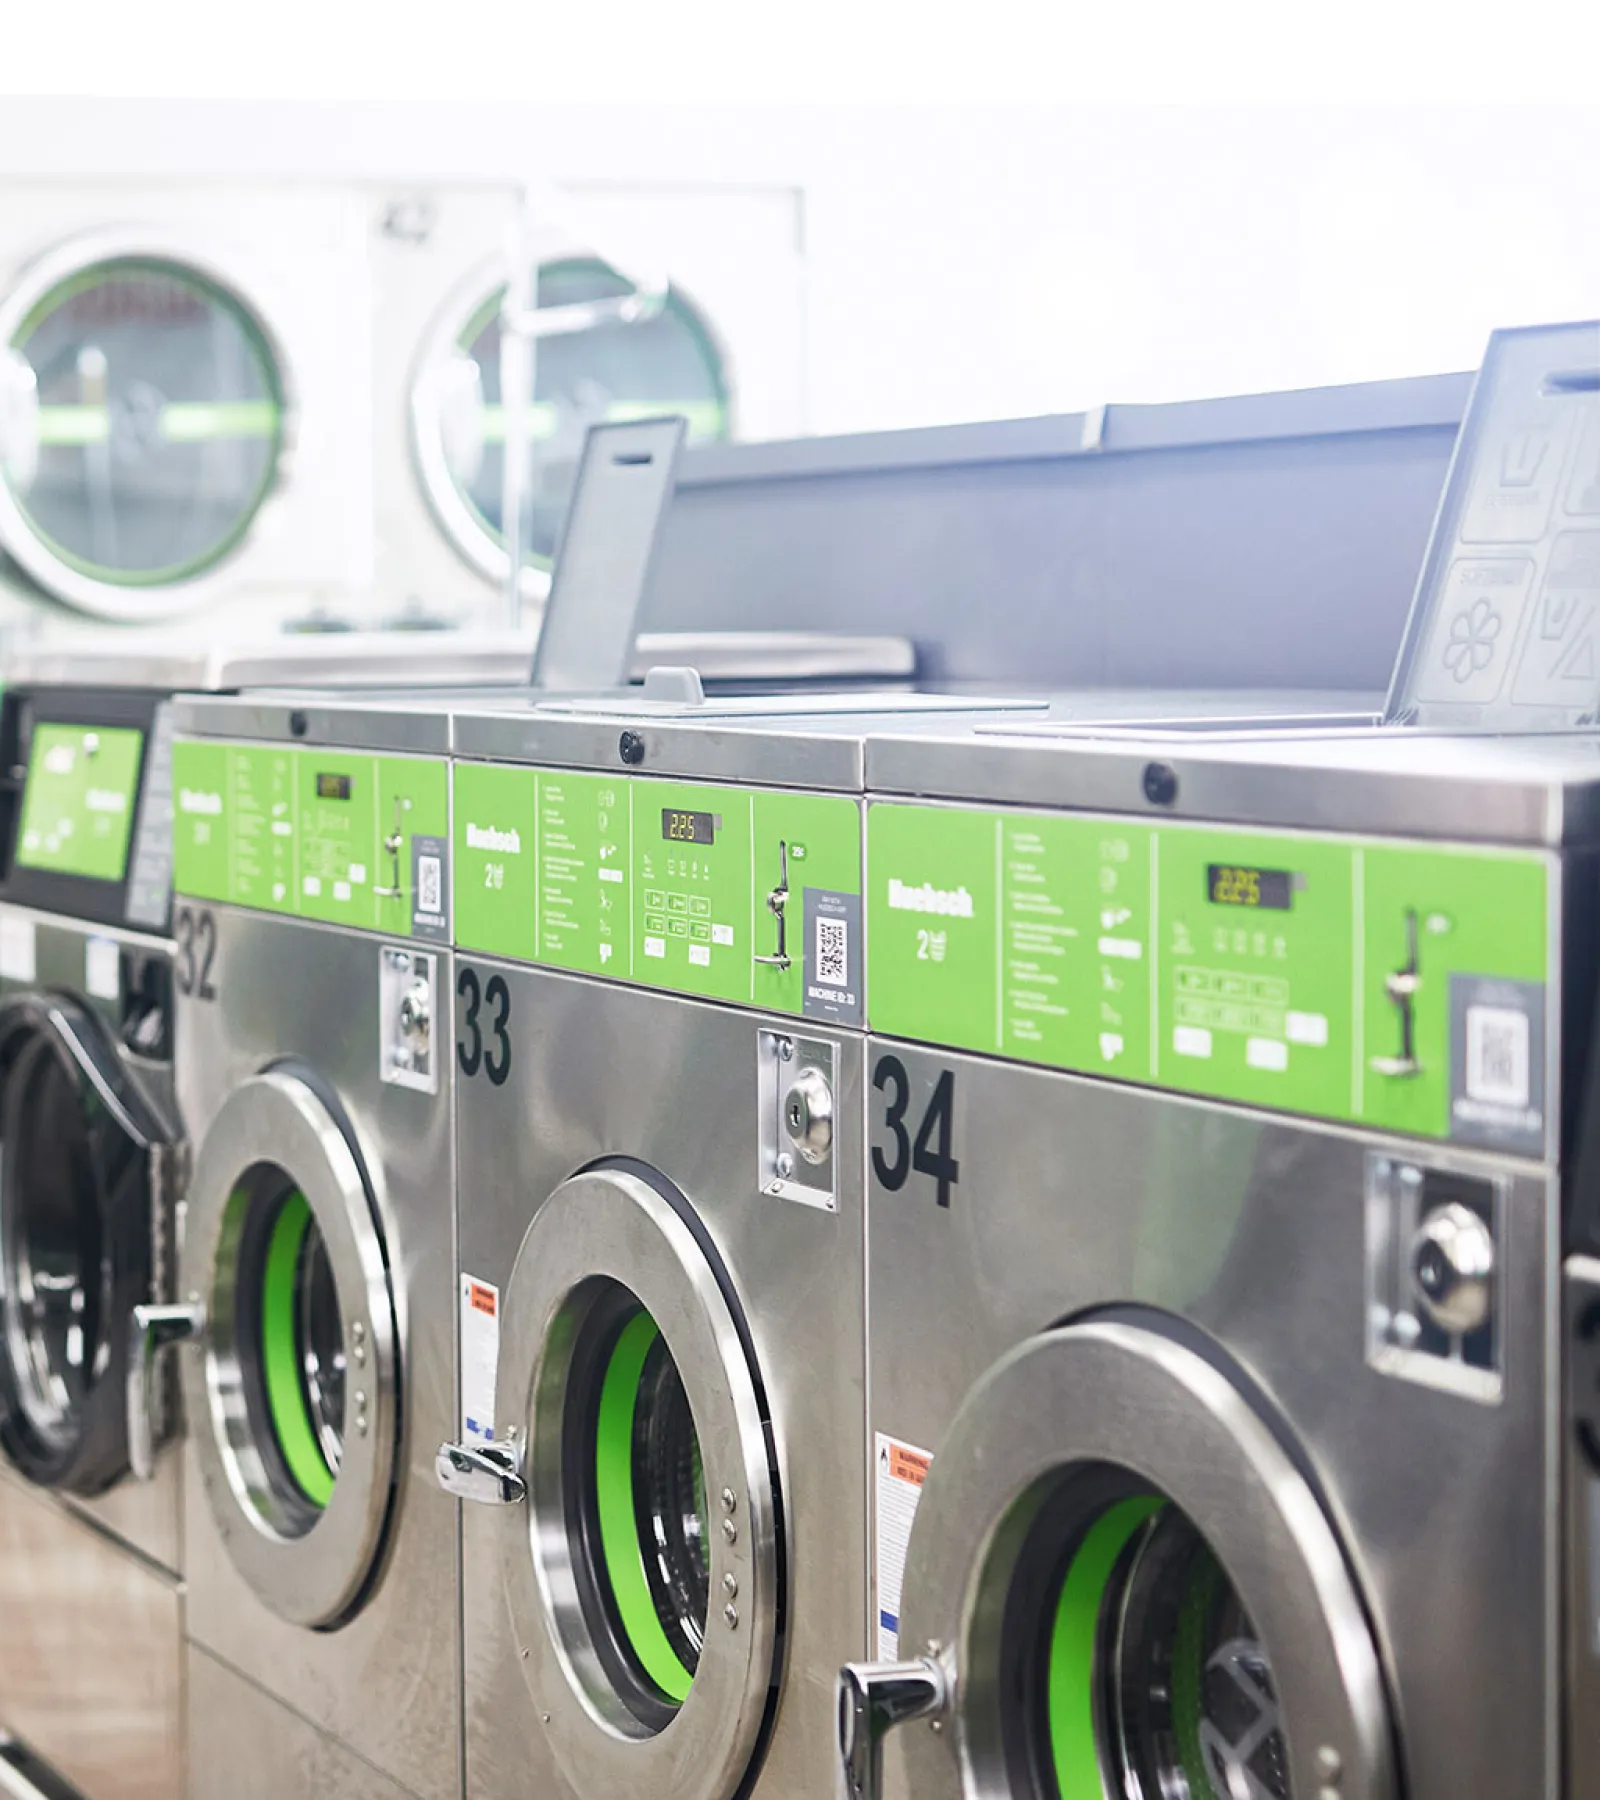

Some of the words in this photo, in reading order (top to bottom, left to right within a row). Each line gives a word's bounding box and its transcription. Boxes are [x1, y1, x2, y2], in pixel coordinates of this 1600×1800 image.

[176, 906, 218, 1001] 32
[457, 967, 511, 1086] 33
[871, 1054, 959, 1208] 34
